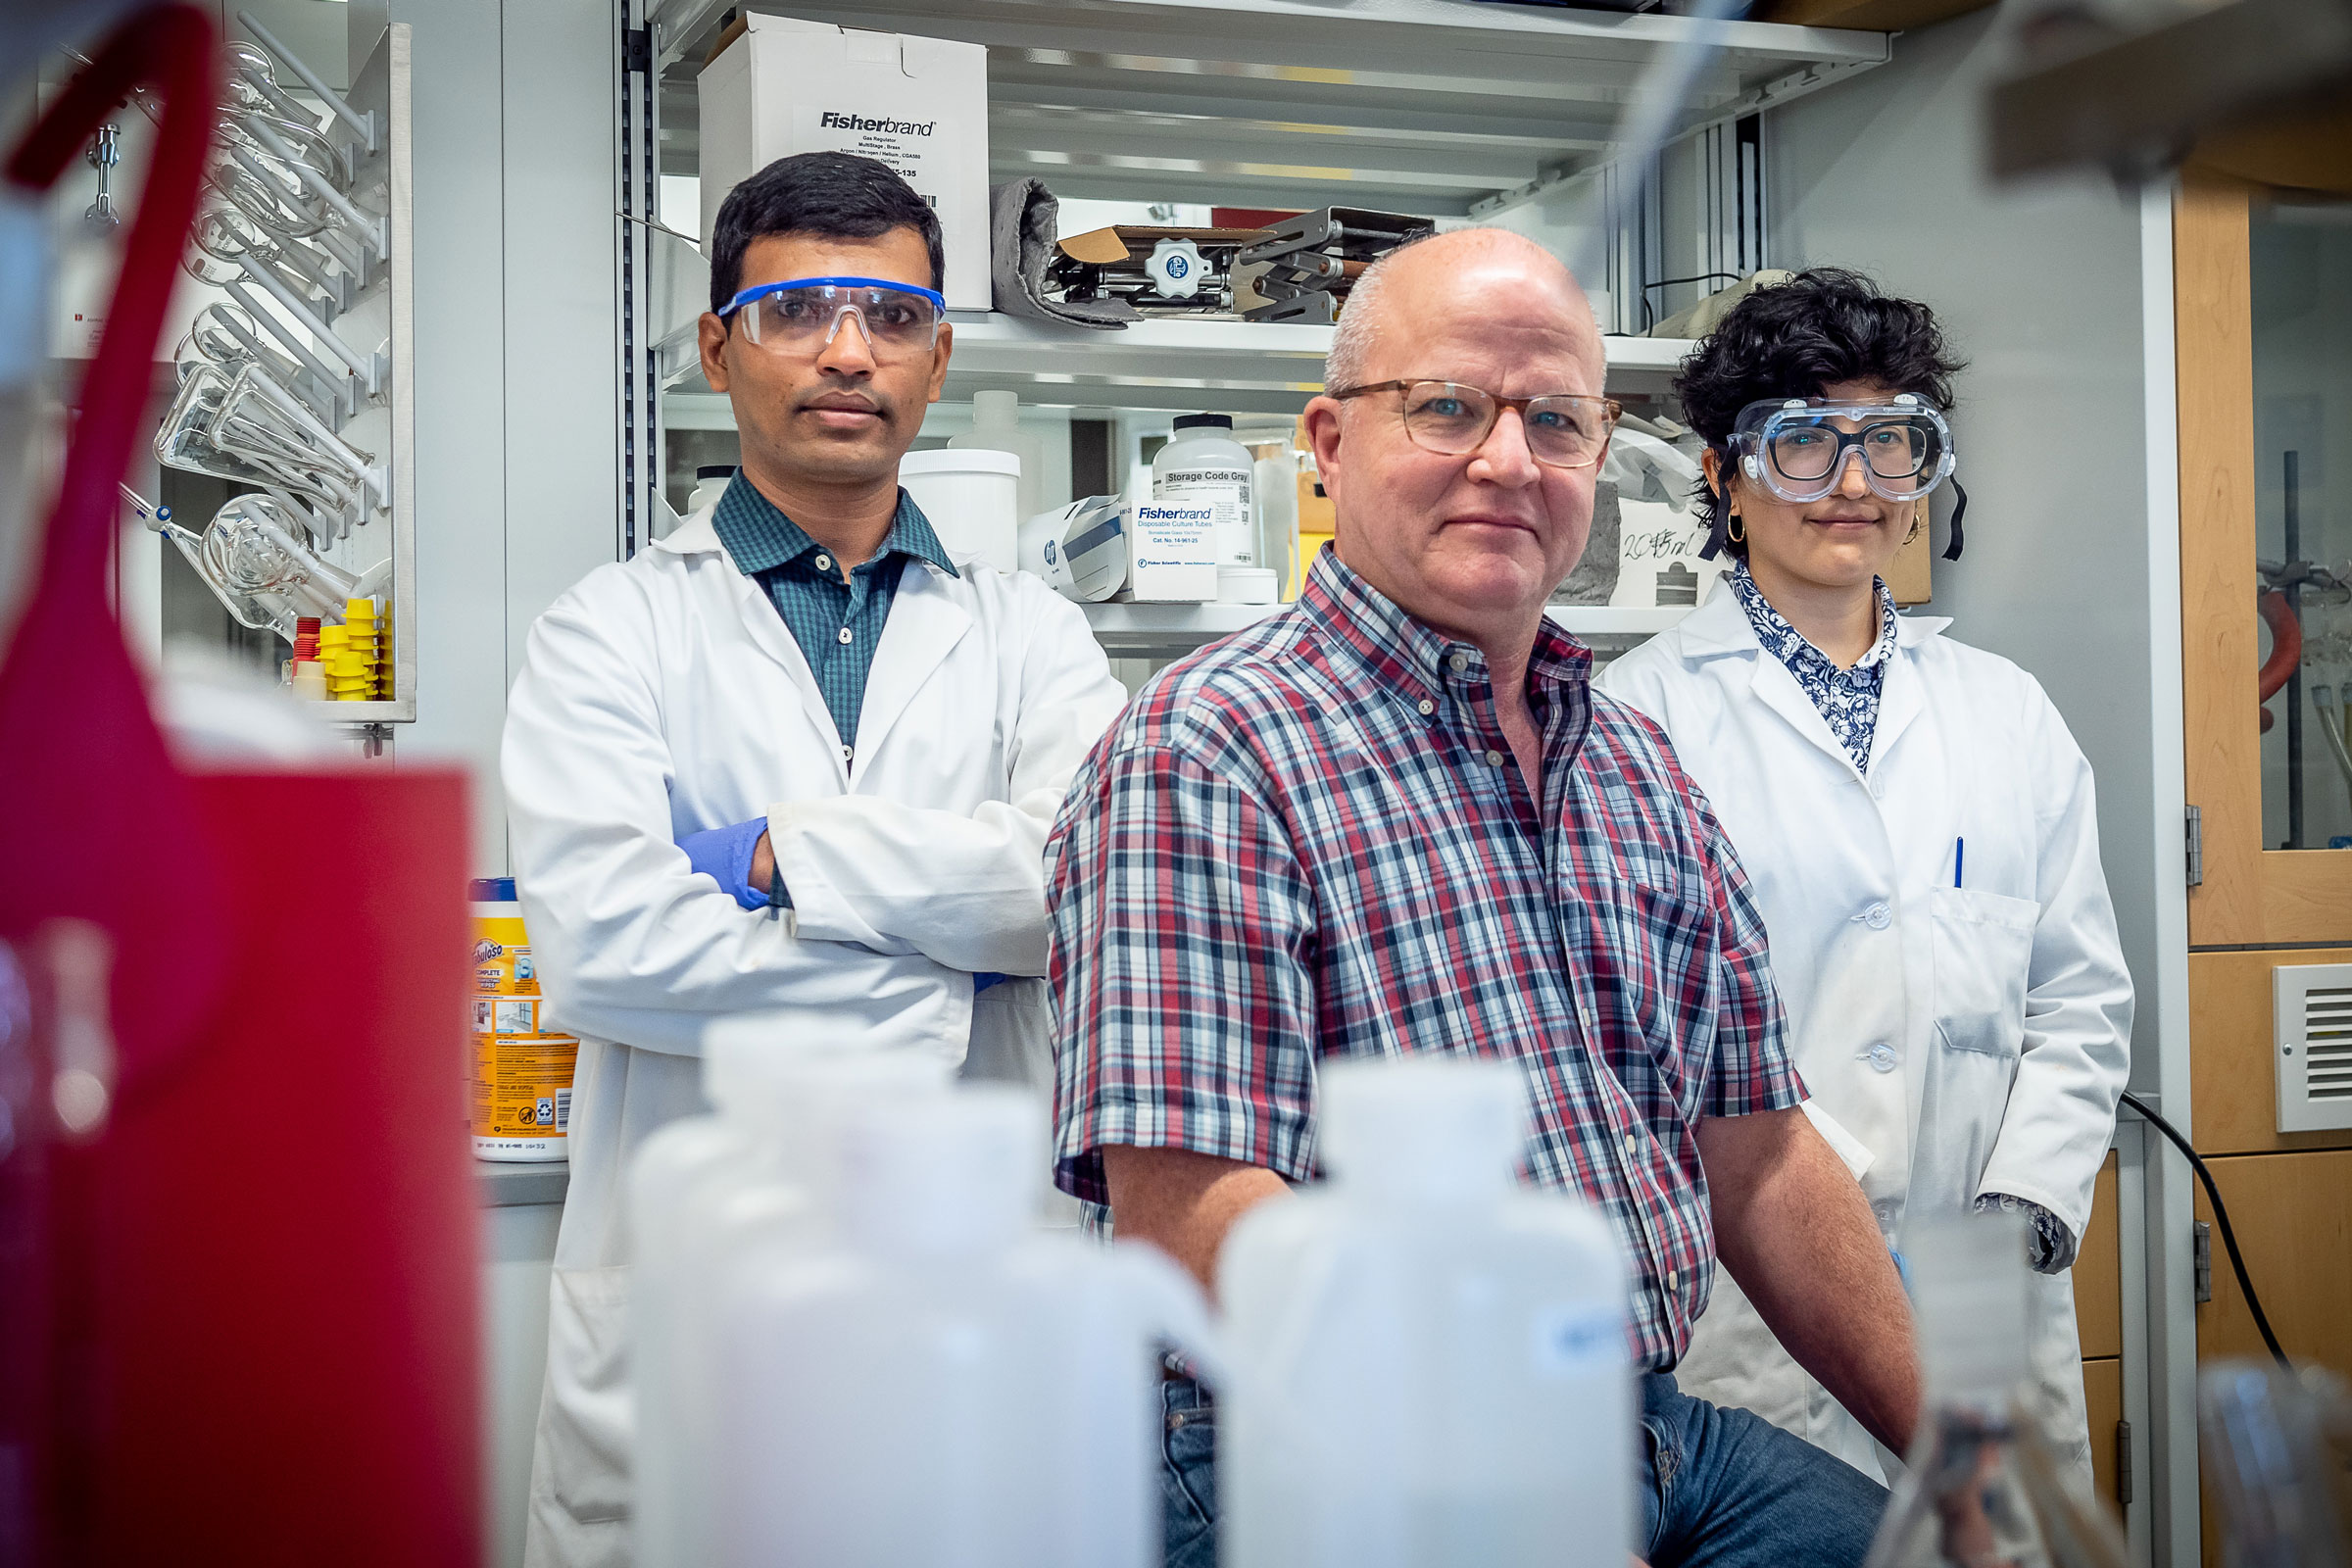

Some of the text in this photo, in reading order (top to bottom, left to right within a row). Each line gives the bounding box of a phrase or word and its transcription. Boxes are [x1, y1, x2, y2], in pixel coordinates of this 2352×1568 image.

[820, 112, 934, 136] Fisherbrand
[1168, 471, 1249, 483] Storage Code Gray
[1139, 508, 1211, 519] Fisherbrand
[472, 944, 504, 965] abuloso
